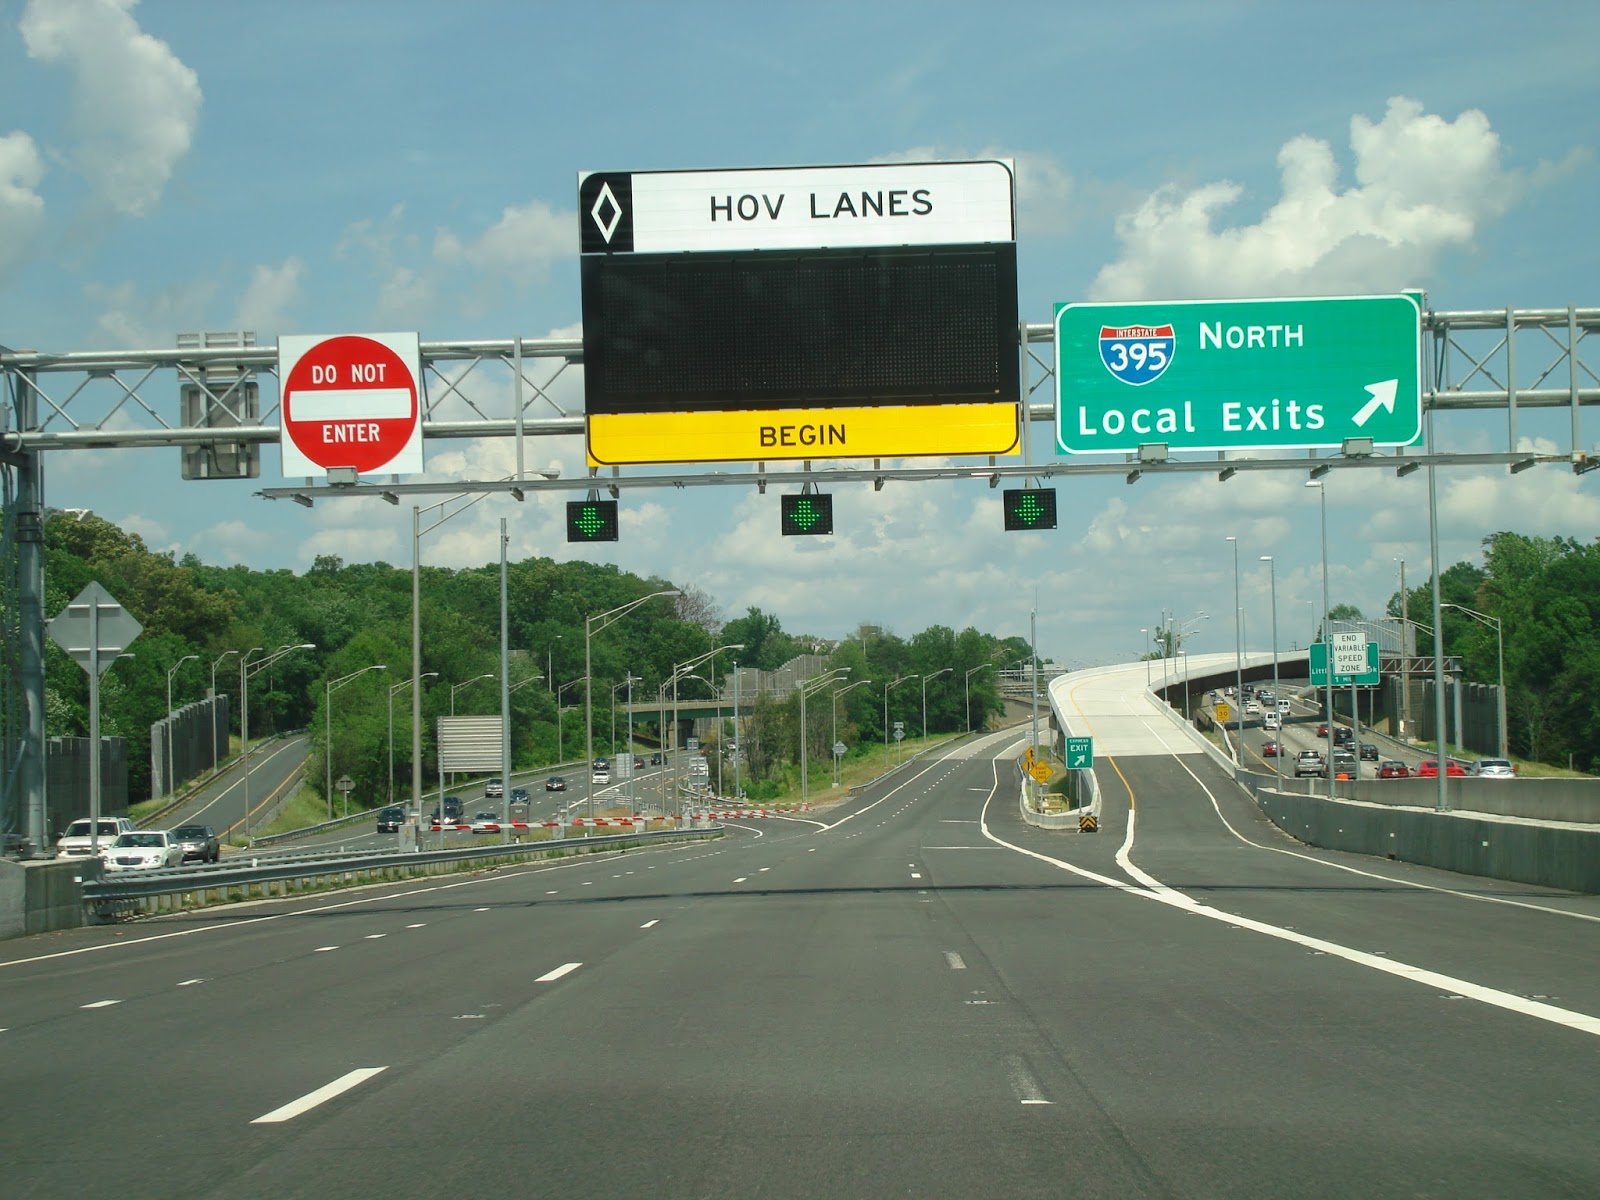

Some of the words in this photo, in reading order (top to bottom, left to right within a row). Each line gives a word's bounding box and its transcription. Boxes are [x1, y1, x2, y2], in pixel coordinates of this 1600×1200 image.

[710, 193, 785, 221] HOV
[810, 189, 933, 219] LANES
[1115, 327, 1158, 338] INTERSTATE
[1199, 321, 1304, 350] NORTH
[1109, 342, 1167, 372] 395
[311, 364, 337, 384] DO
[351, 363, 387, 383] NOT
[1078, 401, 1195, 435] Local
[1222, 398, 1324, 432] Exits
[322, 423, 380, 444] ENTER
[759, 423, 847, 447] BEGIN
[1070, 744, 1089, 752] EXIT
